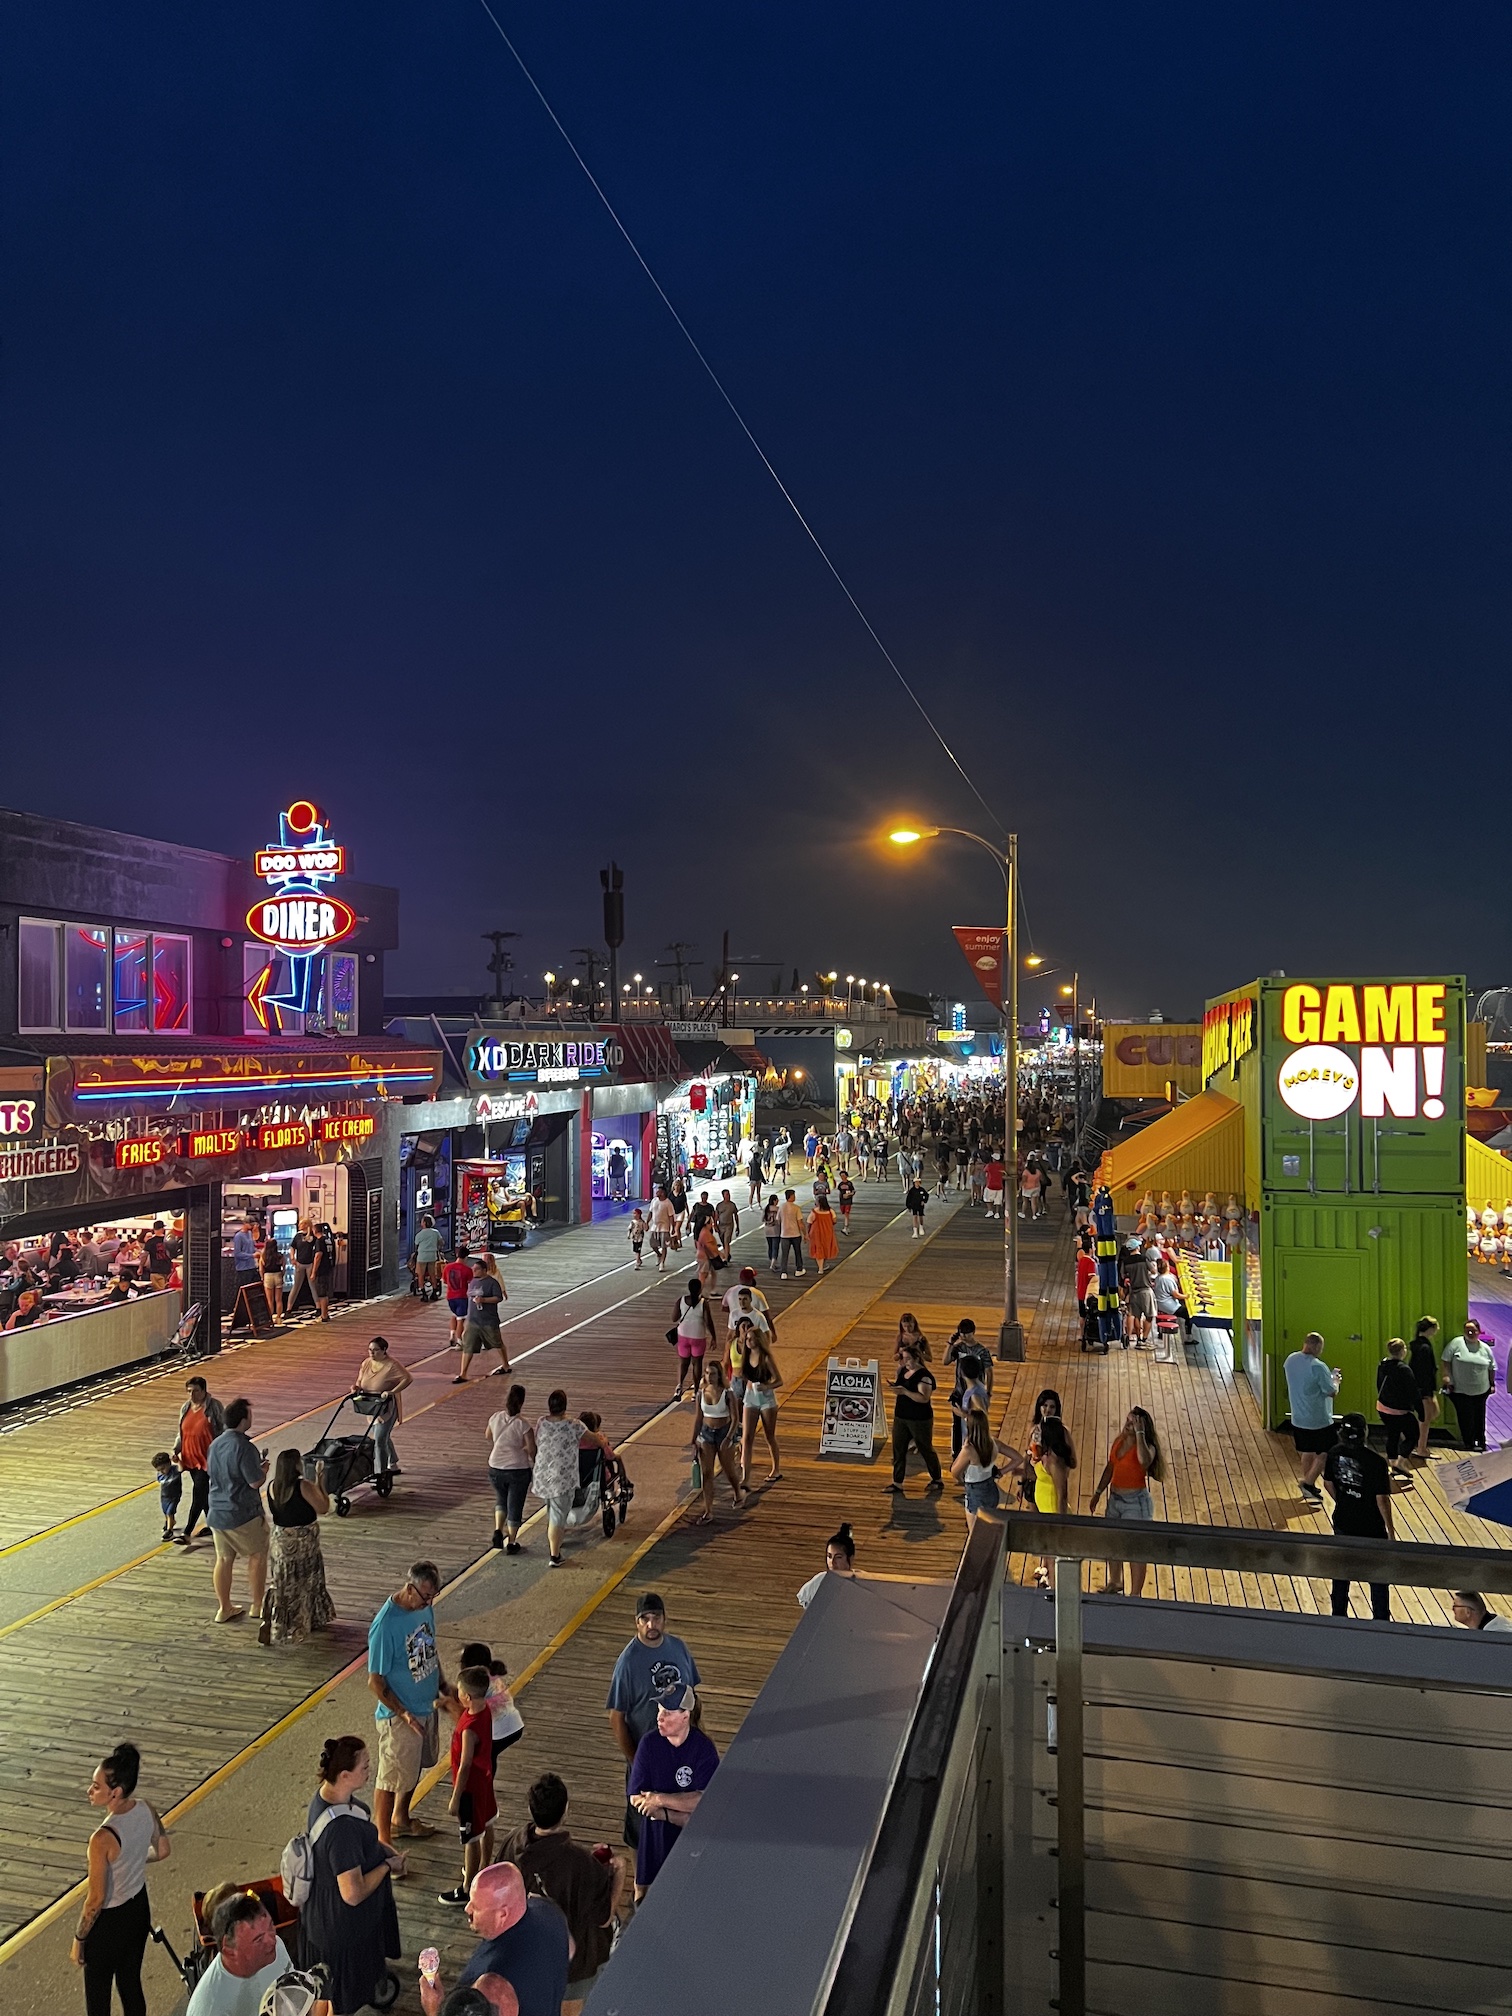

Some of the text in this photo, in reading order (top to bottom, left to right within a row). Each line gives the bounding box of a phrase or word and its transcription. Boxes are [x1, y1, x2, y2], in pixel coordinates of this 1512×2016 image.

[260, 852, 338, 871] DOO WOP
[262, 900, 336, 941] DINER
[975, 935, 1001, 944] enjoy
[1282, 984, 1447, 1044] GAME
[694, 1023, 711, 1032] PLACE
[477, 1046, 508, 1071] XD
[509, 1042, 564, 1068] DARK
[566, 1042, 606, 1067] RIDE
[1284, 1067, 1354, 1090] MOREY'S
[491, 1099, 527, 1120] ESCAPE
[263, 1126, 305, 1148] FLOATS
[324, 1118, 374, 1139] ICE CREAM
[121, 1141, 161, 1165] FRIES
[193, 1131, 236, 1156] MALTS
[831, 1375, 873, 1388] ALOHA
